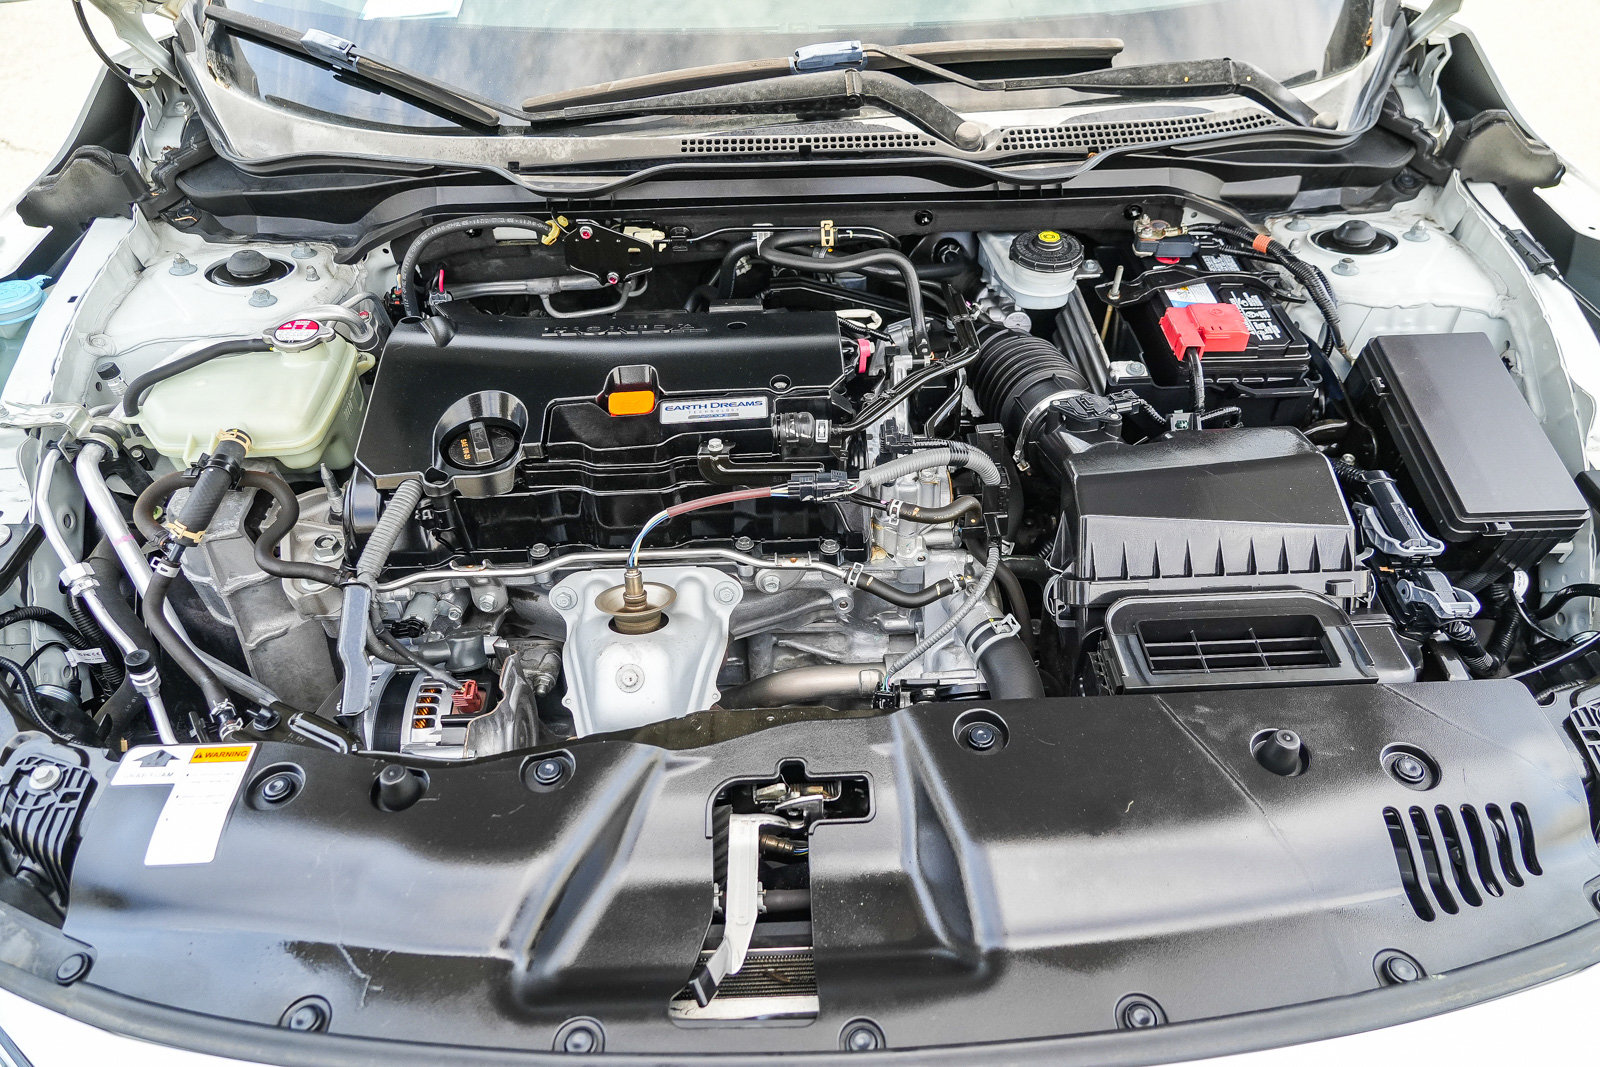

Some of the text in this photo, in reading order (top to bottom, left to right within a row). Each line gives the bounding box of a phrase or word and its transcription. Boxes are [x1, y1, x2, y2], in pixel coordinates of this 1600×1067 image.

[664, 401, 763, 411] EARTH DREAMS
[205, 750, 249, 758] WARNING
